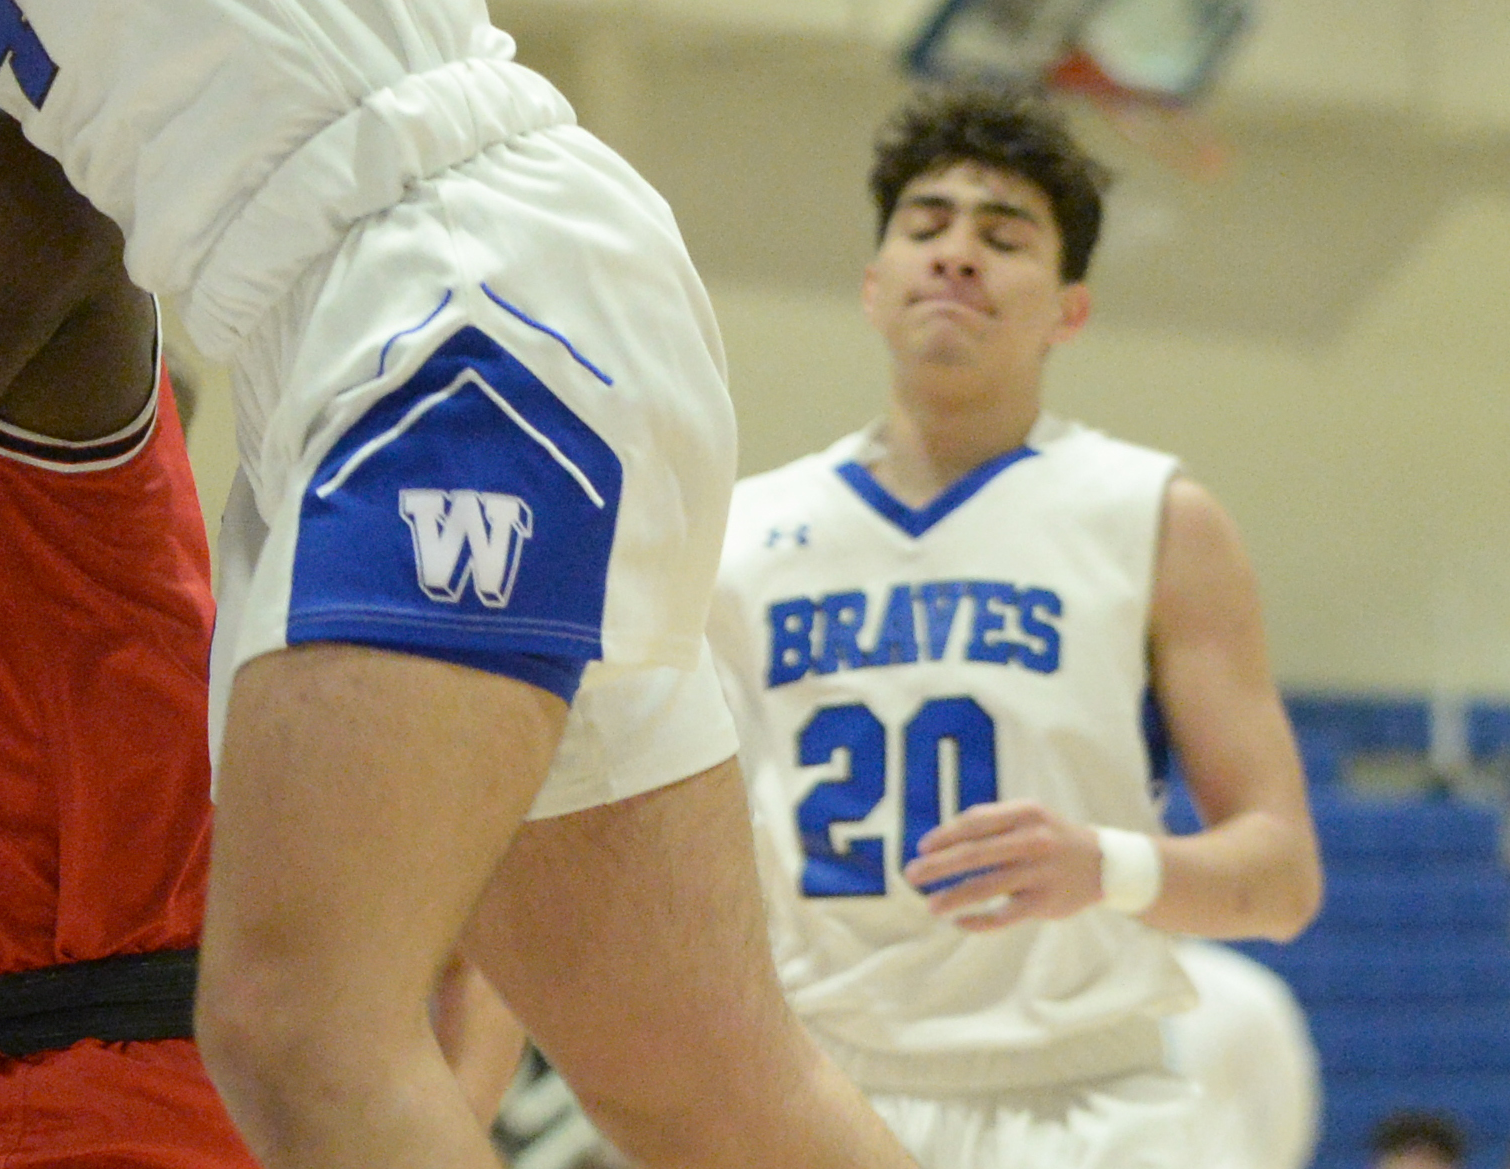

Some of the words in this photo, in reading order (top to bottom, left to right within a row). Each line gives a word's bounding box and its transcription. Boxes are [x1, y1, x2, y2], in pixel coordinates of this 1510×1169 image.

[398, 488, 533, 608] W
[766, 578, 1063, 689] BRAVES
[794, 695, 999, 899] 20
